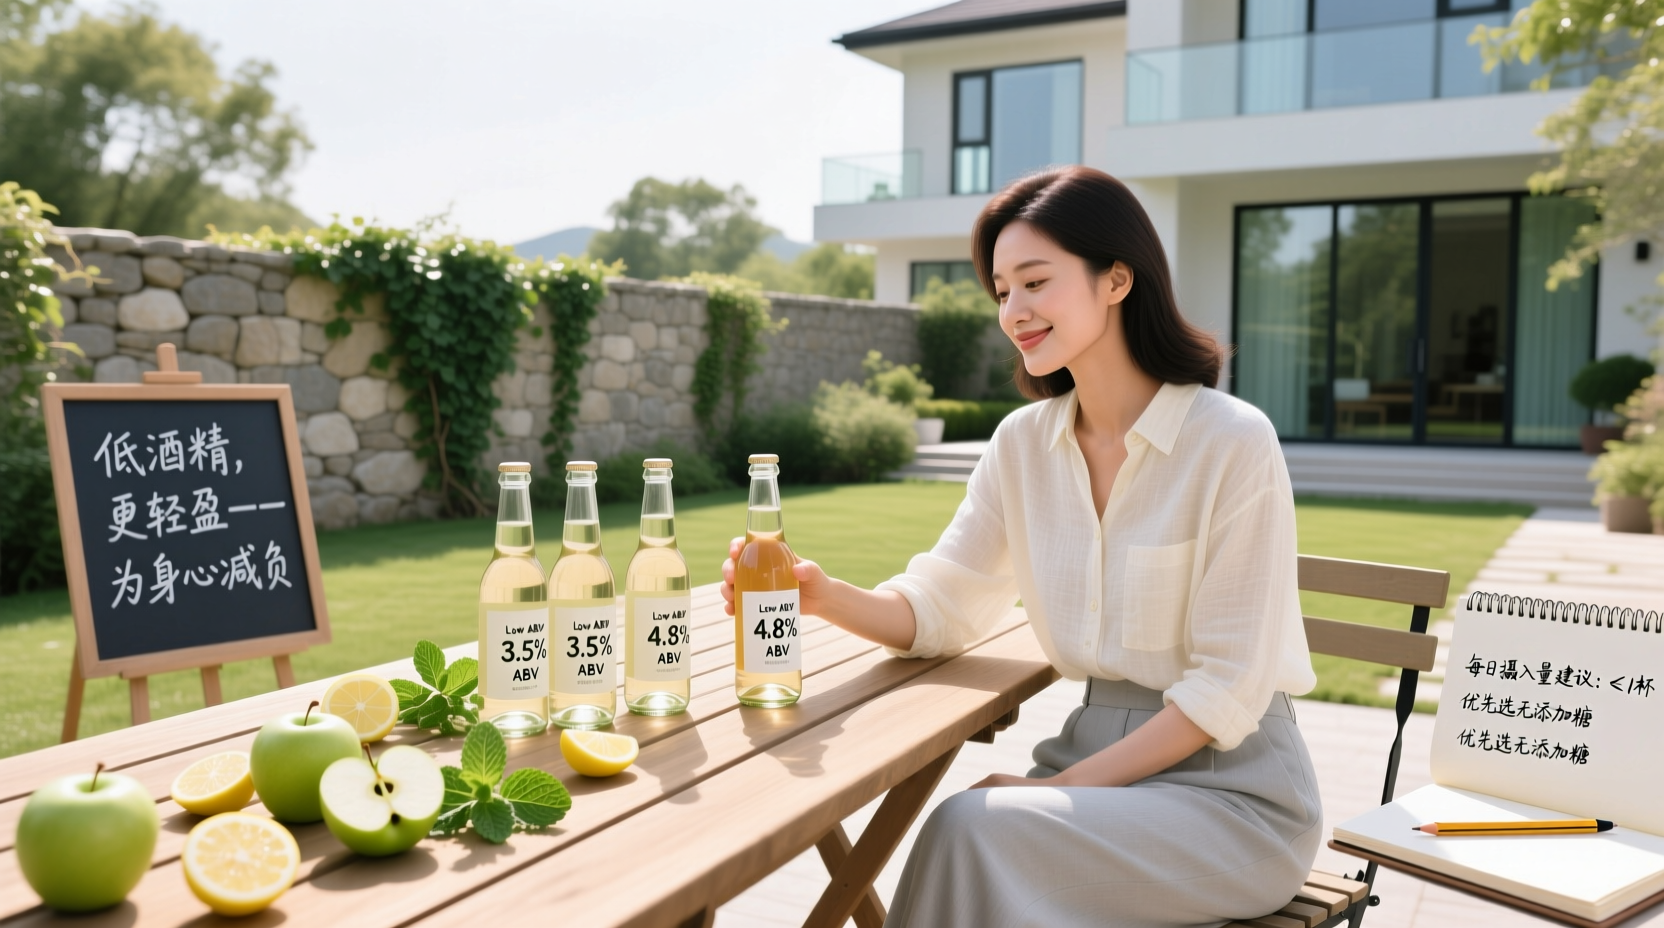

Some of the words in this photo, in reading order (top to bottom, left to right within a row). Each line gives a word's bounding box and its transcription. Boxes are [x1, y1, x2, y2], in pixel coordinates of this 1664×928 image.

[111, 540, 292, 609] 为身心减负
[647, 624, 689, 646] 4.8%
[754, 617, 797, 640] 4.8%
[501, 638, 546, 663] 3.5%
[566, 634, 612, 658] 3.5%
[766, 644, 790, 657] ABV
[578, 663, 604, 676] ABV
[657, 651, 682, 665] ABV
[513, 667, 539, 682] ABV
[1460, 692, 1593, 727] 优先选无添加糖
[1457, 728, 1589, 765] 优先选无添加糖
